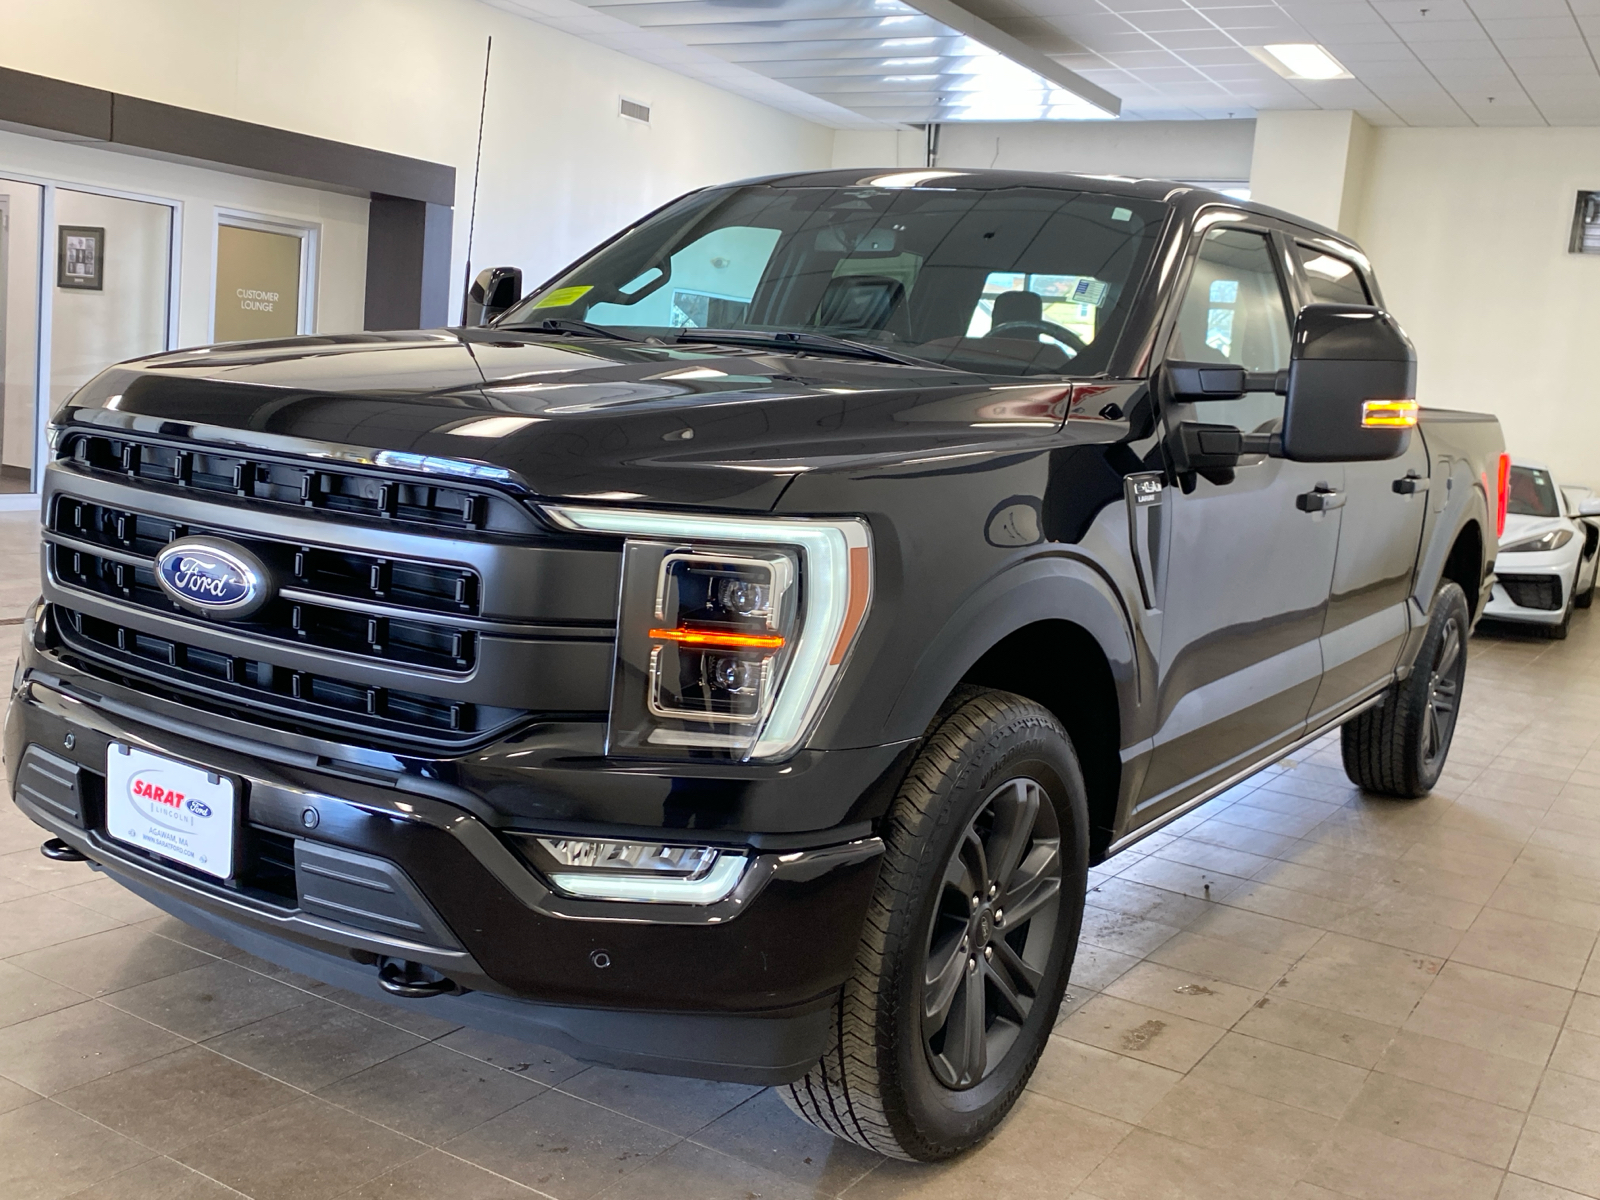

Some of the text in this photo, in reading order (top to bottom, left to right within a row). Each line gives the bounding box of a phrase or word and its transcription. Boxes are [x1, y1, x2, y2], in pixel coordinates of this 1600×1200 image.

[236, 288, 279, 301] CUSTOMER
[241, 300, 274, 312] LOUNGE
[174, 557, 228, 597] Ford
[133, 779, 184, 809] SARAT
[155, 806, 188, 822] LINCOLN
[190, 800, 209, 816] Ford
[178, 838, 189, 847] MA
